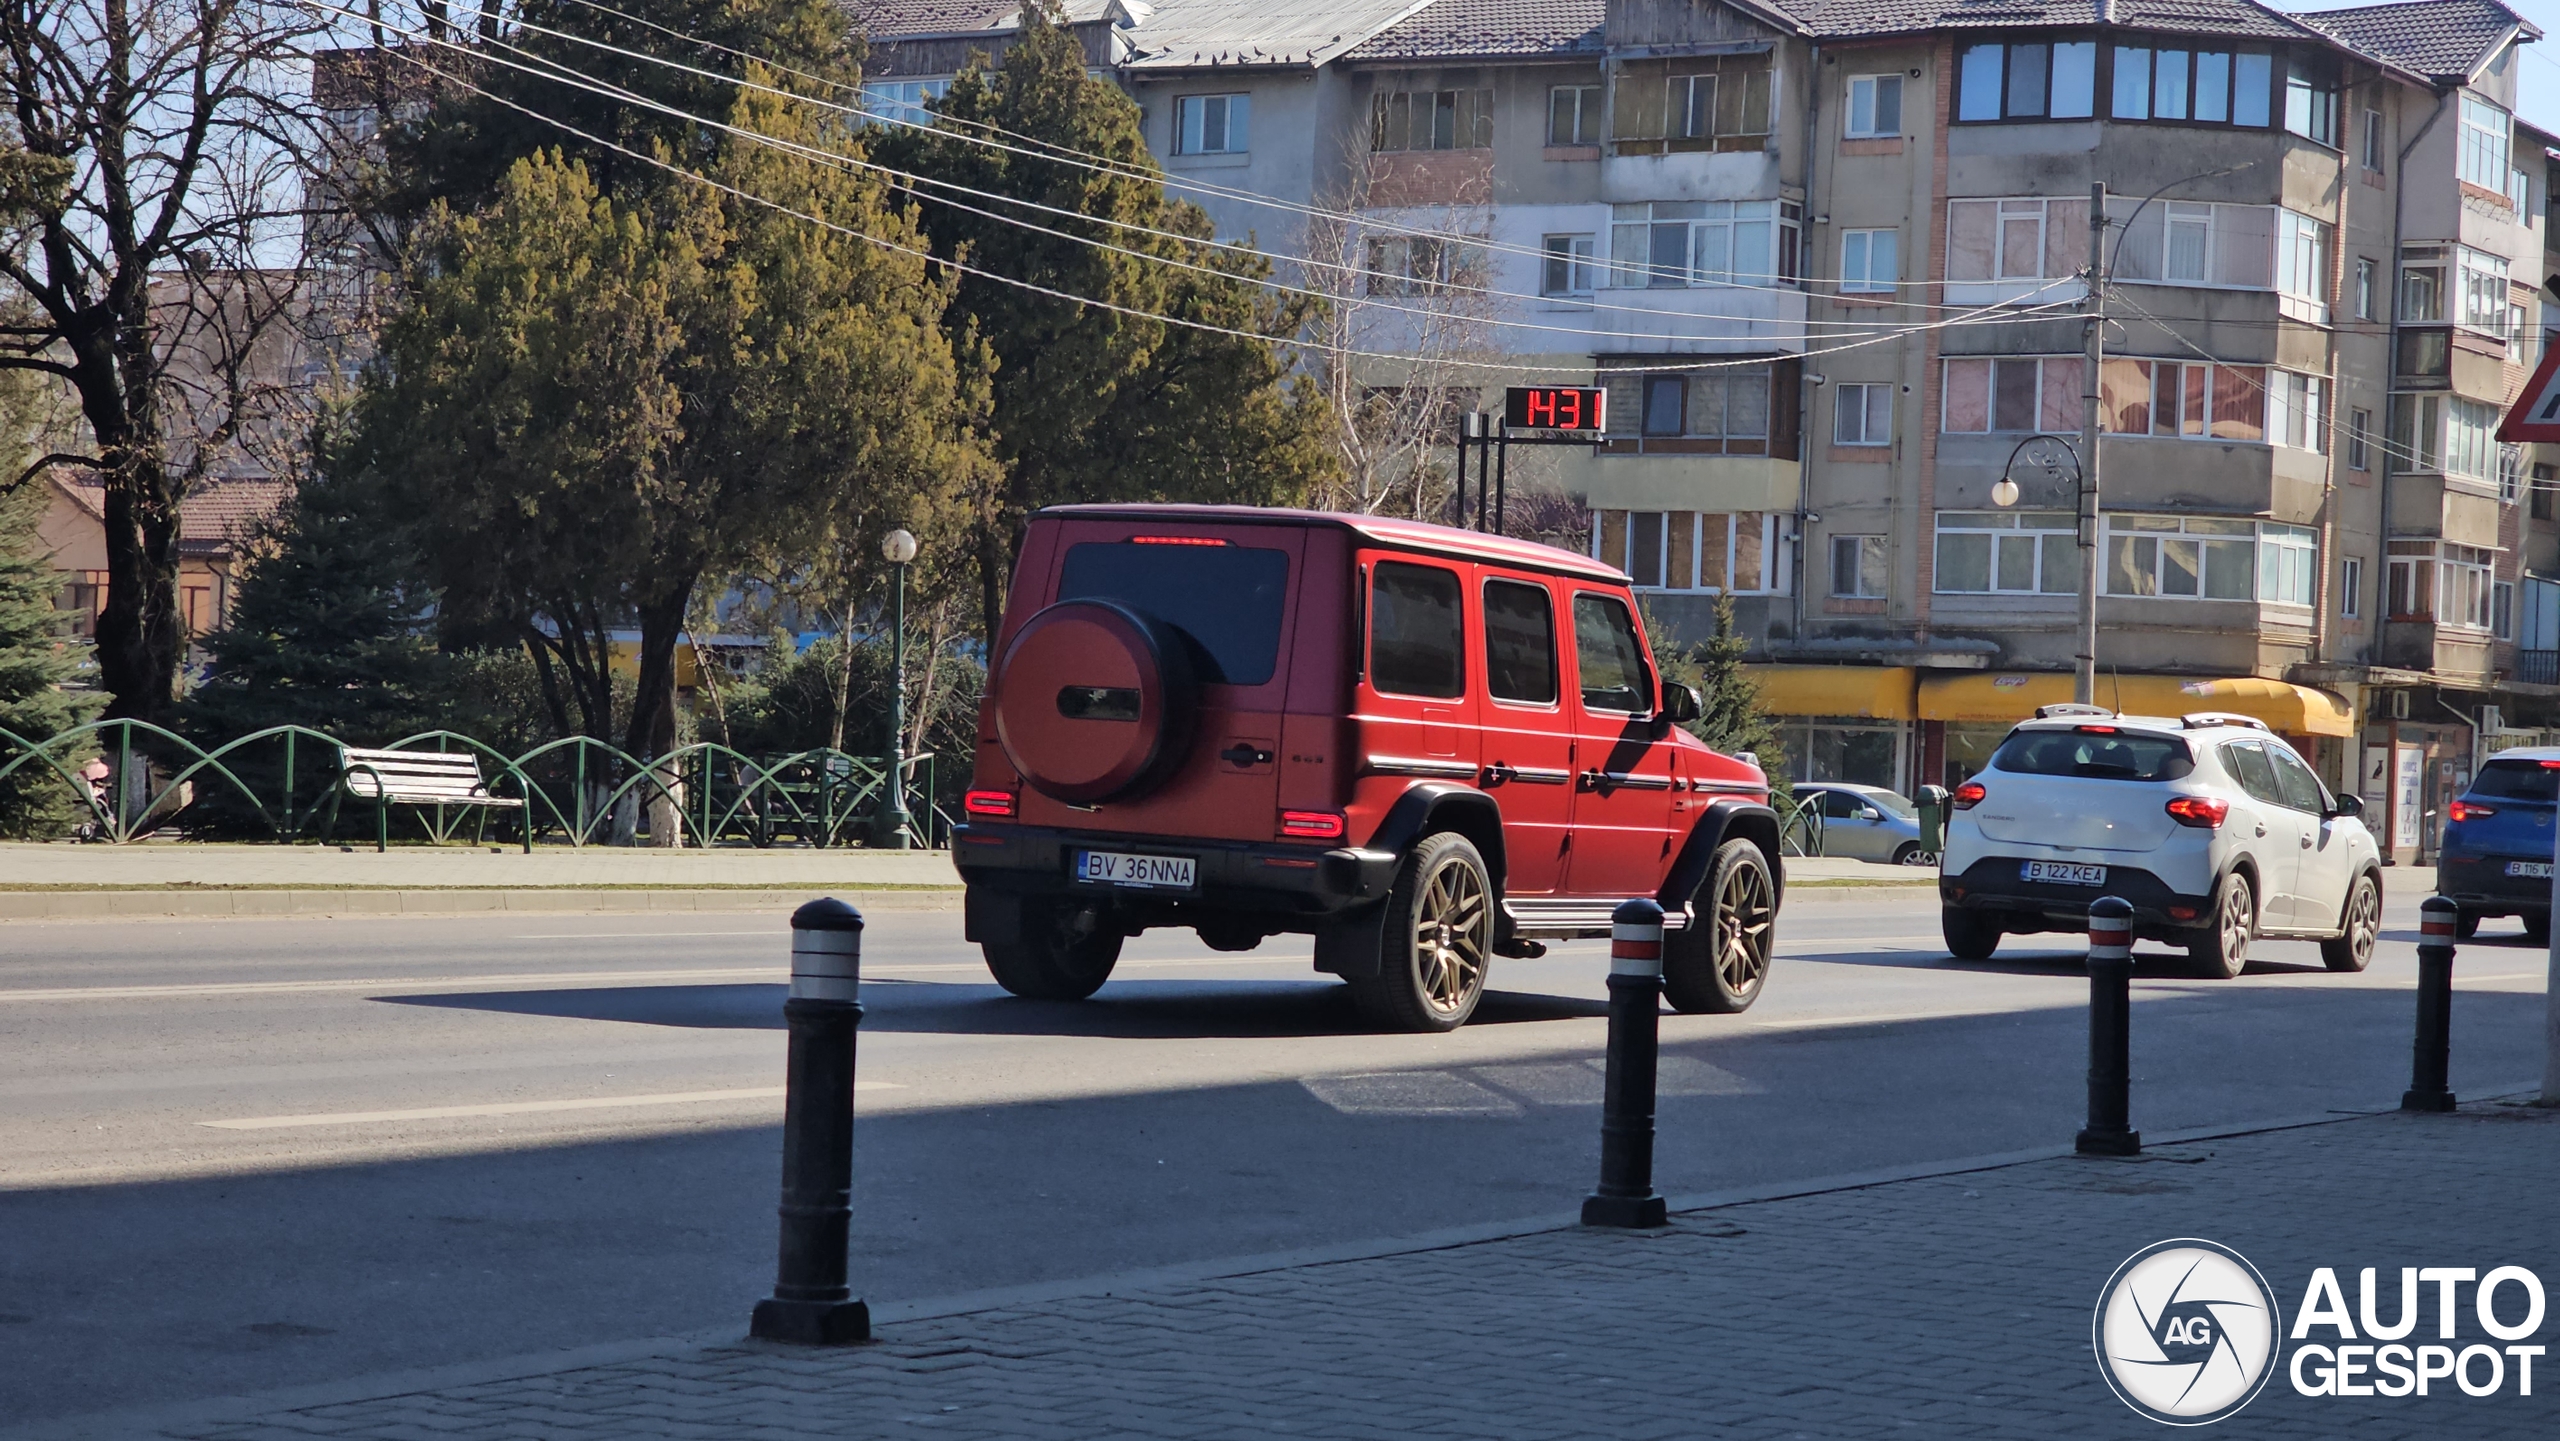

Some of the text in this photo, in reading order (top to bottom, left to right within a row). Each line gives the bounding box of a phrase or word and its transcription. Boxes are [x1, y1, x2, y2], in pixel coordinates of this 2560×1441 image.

[1982, 814, 2016, 822] SANDERO
[1089, 855, 1117, 877] BV
[2031, 863, 2101, 882] B 122 KEA
[2512, 863, 2521, 874] B
[2525, 864, 2539, 875] 116
